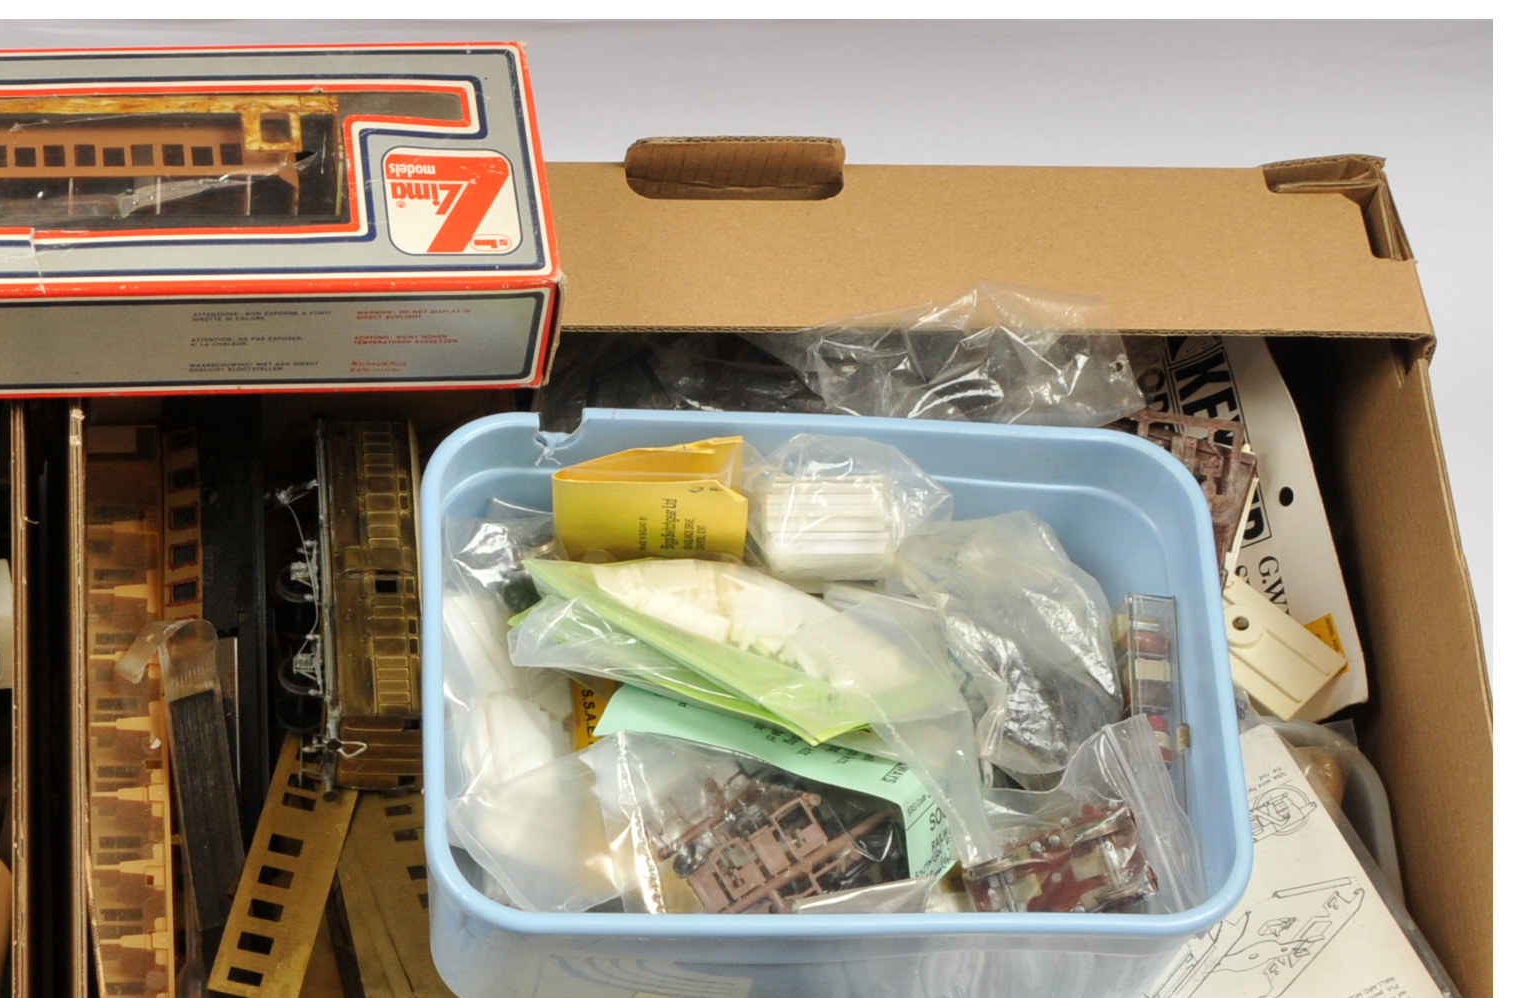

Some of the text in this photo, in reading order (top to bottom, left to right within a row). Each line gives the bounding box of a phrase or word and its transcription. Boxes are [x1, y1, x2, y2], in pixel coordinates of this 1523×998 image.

[388, 163, 436, 177] models
[662, 498, 676, 508] Ltd
[661, 509, 679, 538] Switchgear
[1362, 974, 1394, 995] MALLARD
